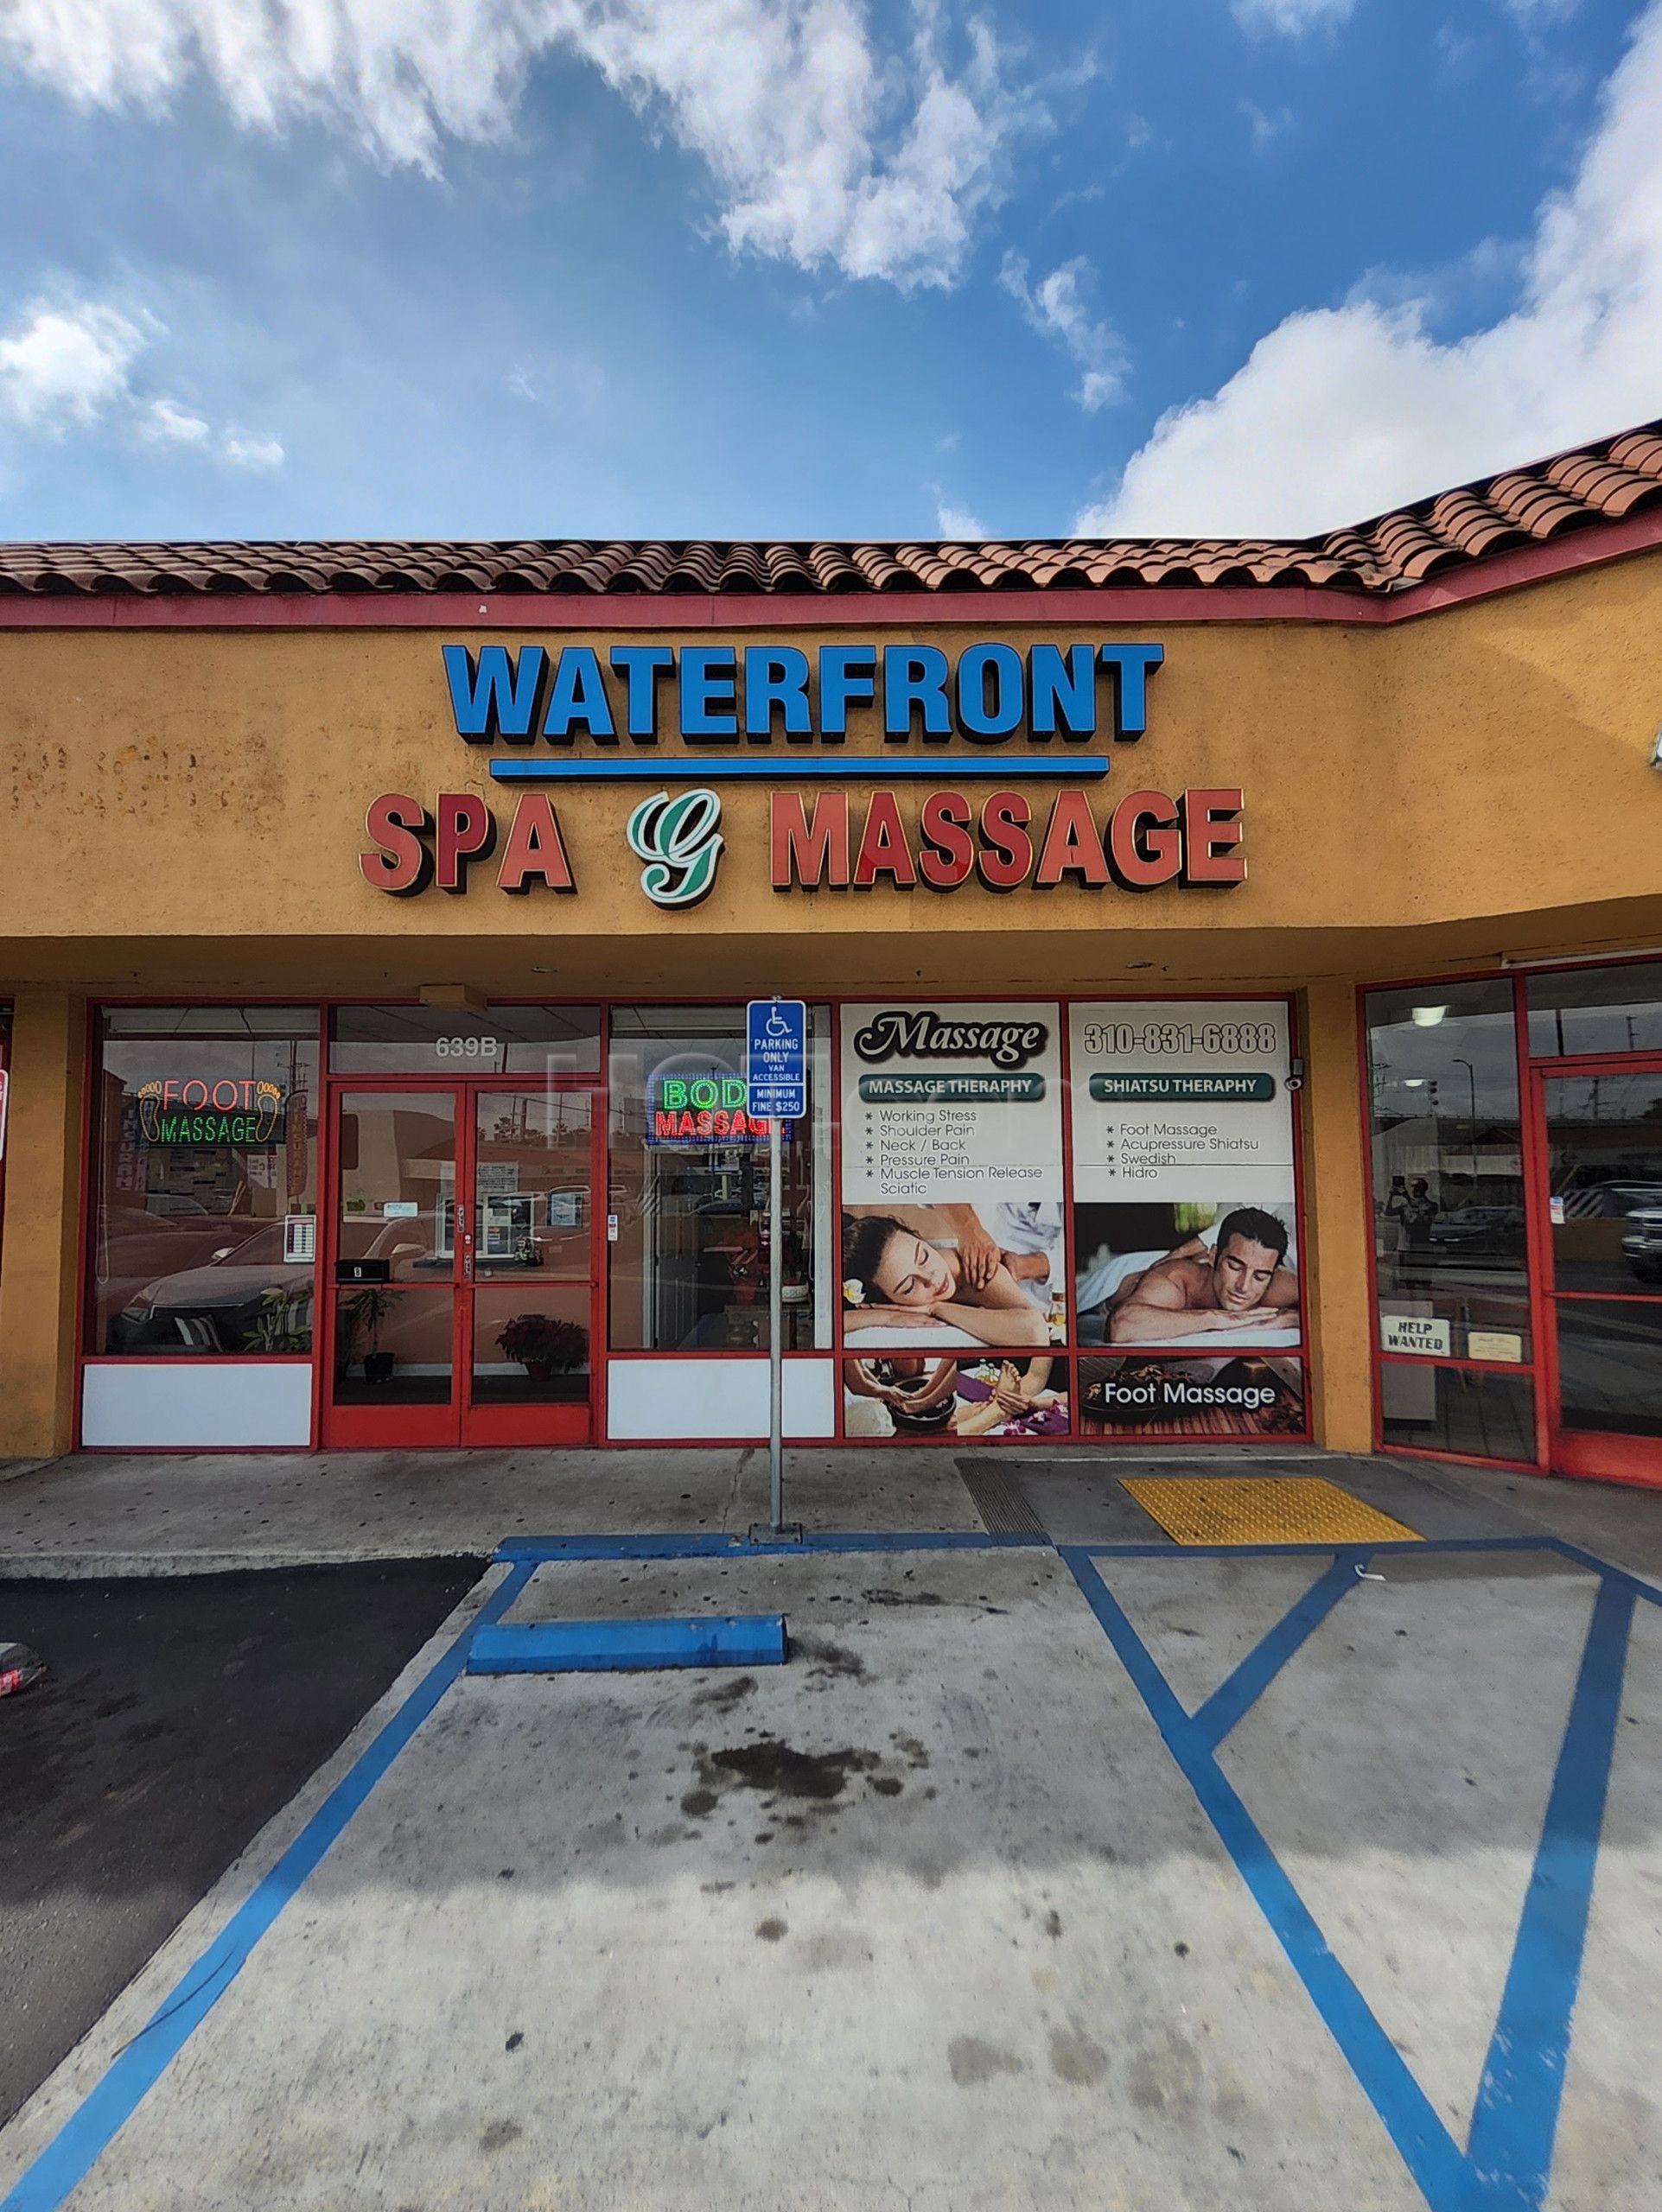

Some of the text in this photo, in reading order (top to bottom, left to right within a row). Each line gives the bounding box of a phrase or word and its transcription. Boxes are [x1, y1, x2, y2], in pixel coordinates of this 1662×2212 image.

[442, 643, 1165, 744] WATERFRONT
[359, 791, 577, 897] SPA
[770, 787, 1248, 893] MASSAGE
[754, 1039, 799, 1051] PARKING
[857, 1014, 1042, 1064] Massage
[1084, 1023, 1277, 1054] 310-831-6888
[436, 1037, 498, 1058] 639B
[762, 1052, 789, 1064] ONLY
[752, 1073, 801, 1082] ACCESSIBLE
[869, 1079, 1033, 1094] MASSAGE THERAPHY
[1104, 1079, 1258, 1093] SHIATSU THERAPHY
[162, 1078, 258, 1111] FOOT
[663, 1079, 748, 1109] BOD
[756, 1089, 796, 1099] MINIMUM
[752, 1102, 800, 1113] FINE $250
[879, 1109, 977, 1124] Working Stress
[161, 1116, 257, 1143] MASSAGE
[880, 1125, 975, 1137] Shoulder Pain
[1120, 1123, 1218, 1138] Foot Massage
[880, 1140, 916, 1151] Neck
[932, 1139, 966, 1151] Back
[1120, 1138, 1259, 1152] Acupressure Shiatsu
[880, 1154, 970, 1166] Pressure Pain
[1121, 1153, 1176, 1165] Swedish
[880, 1166, 1043, 1179] Muscle Tension Release
[1122, 1166, 1158, 1179] Hidro
[880, 1183, 927, 1195] Sciatic
[1398, 1321, 1433, 1335] HELP
[1388, 1334, 1443, 1350] WANTED
[1105, 1382, 1276, 1409] Foot Massage
